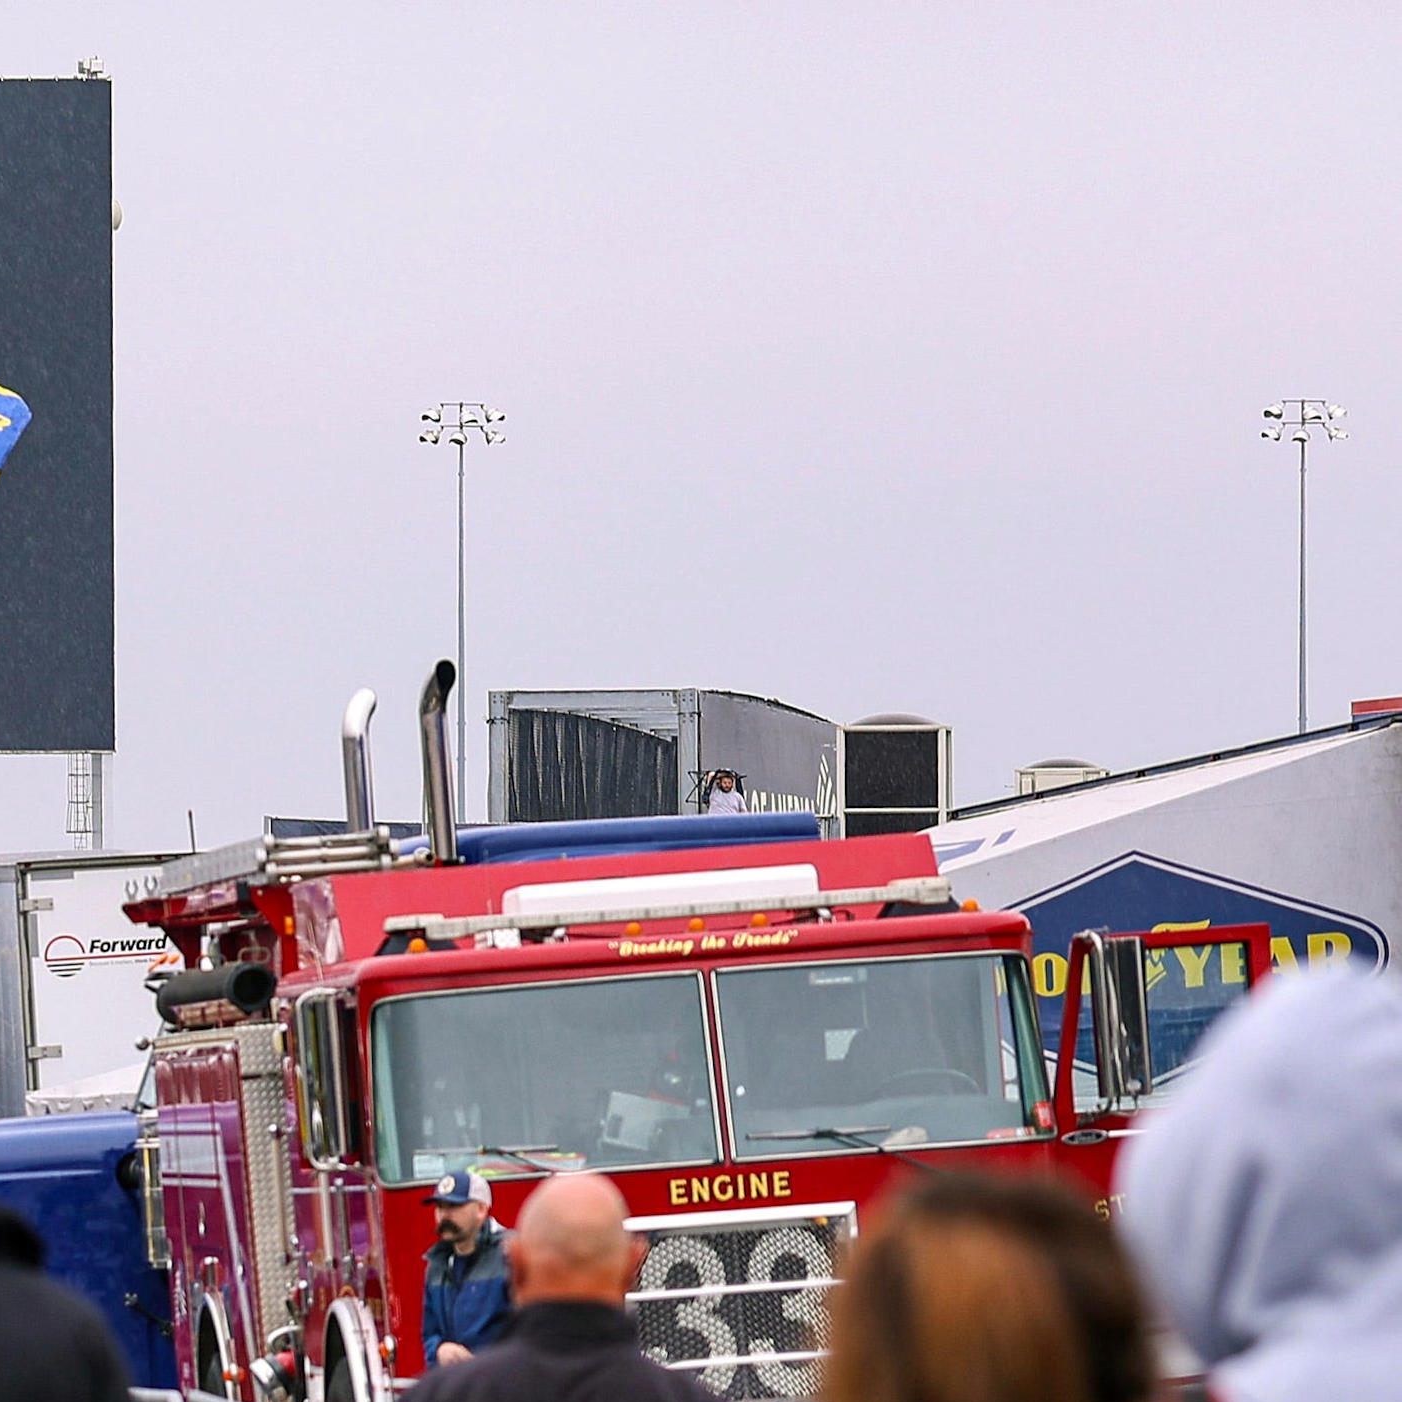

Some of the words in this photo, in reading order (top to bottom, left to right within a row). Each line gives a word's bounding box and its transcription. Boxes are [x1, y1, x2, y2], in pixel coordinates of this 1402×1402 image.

[89, 933, 169, 954] Forward
[700, 934, 727, 950] the
[670, 1171, 792, 1205] ENGINE
